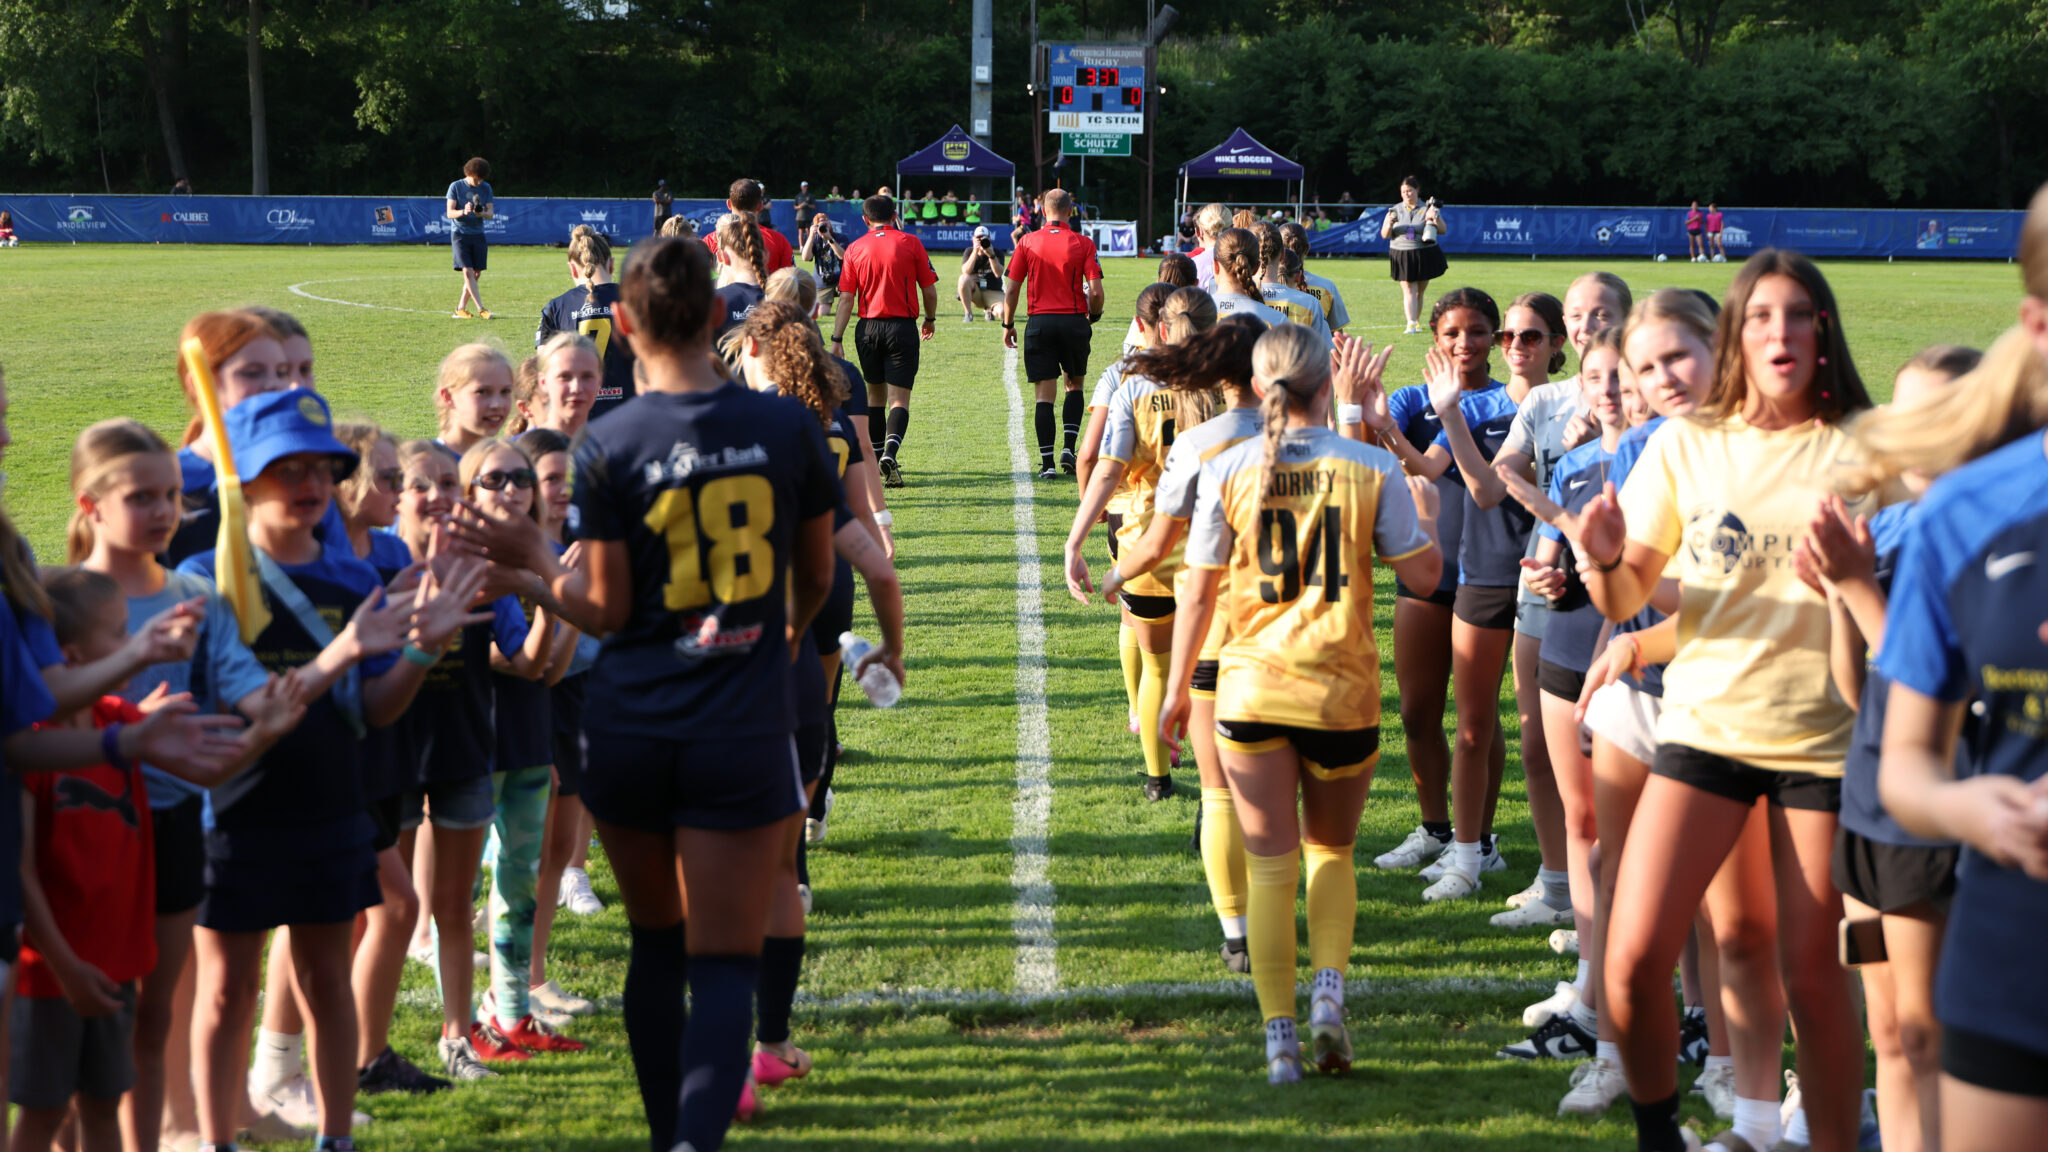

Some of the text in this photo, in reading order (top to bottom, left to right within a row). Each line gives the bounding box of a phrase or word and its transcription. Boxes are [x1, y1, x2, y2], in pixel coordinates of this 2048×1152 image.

[1083, 57, 1119, 66] RUGBY
[1053, 76, 1073, 85] HOME
[1062, 86, 1073, 104] 0
[1130, 87, 1142, 105] 0
[1087, 116, 1140, 124] TC STEIN
[1074, 139, 1118, 148] SCHULTZ
[1215, 155, 1272, 164] NIKE SOCCER
[173, 212, 209, 222] CALIBER
[57, 221, 107, 229] BRIDGEVIEW
[568, 223, 620, 233] RYAL
[1483, 231, 1533, 242] ROYAL
[1219, 302, 1235, 310] PGH
[643, 474, 775, 611] 18
[1258, 505, 1349, 604] 94
